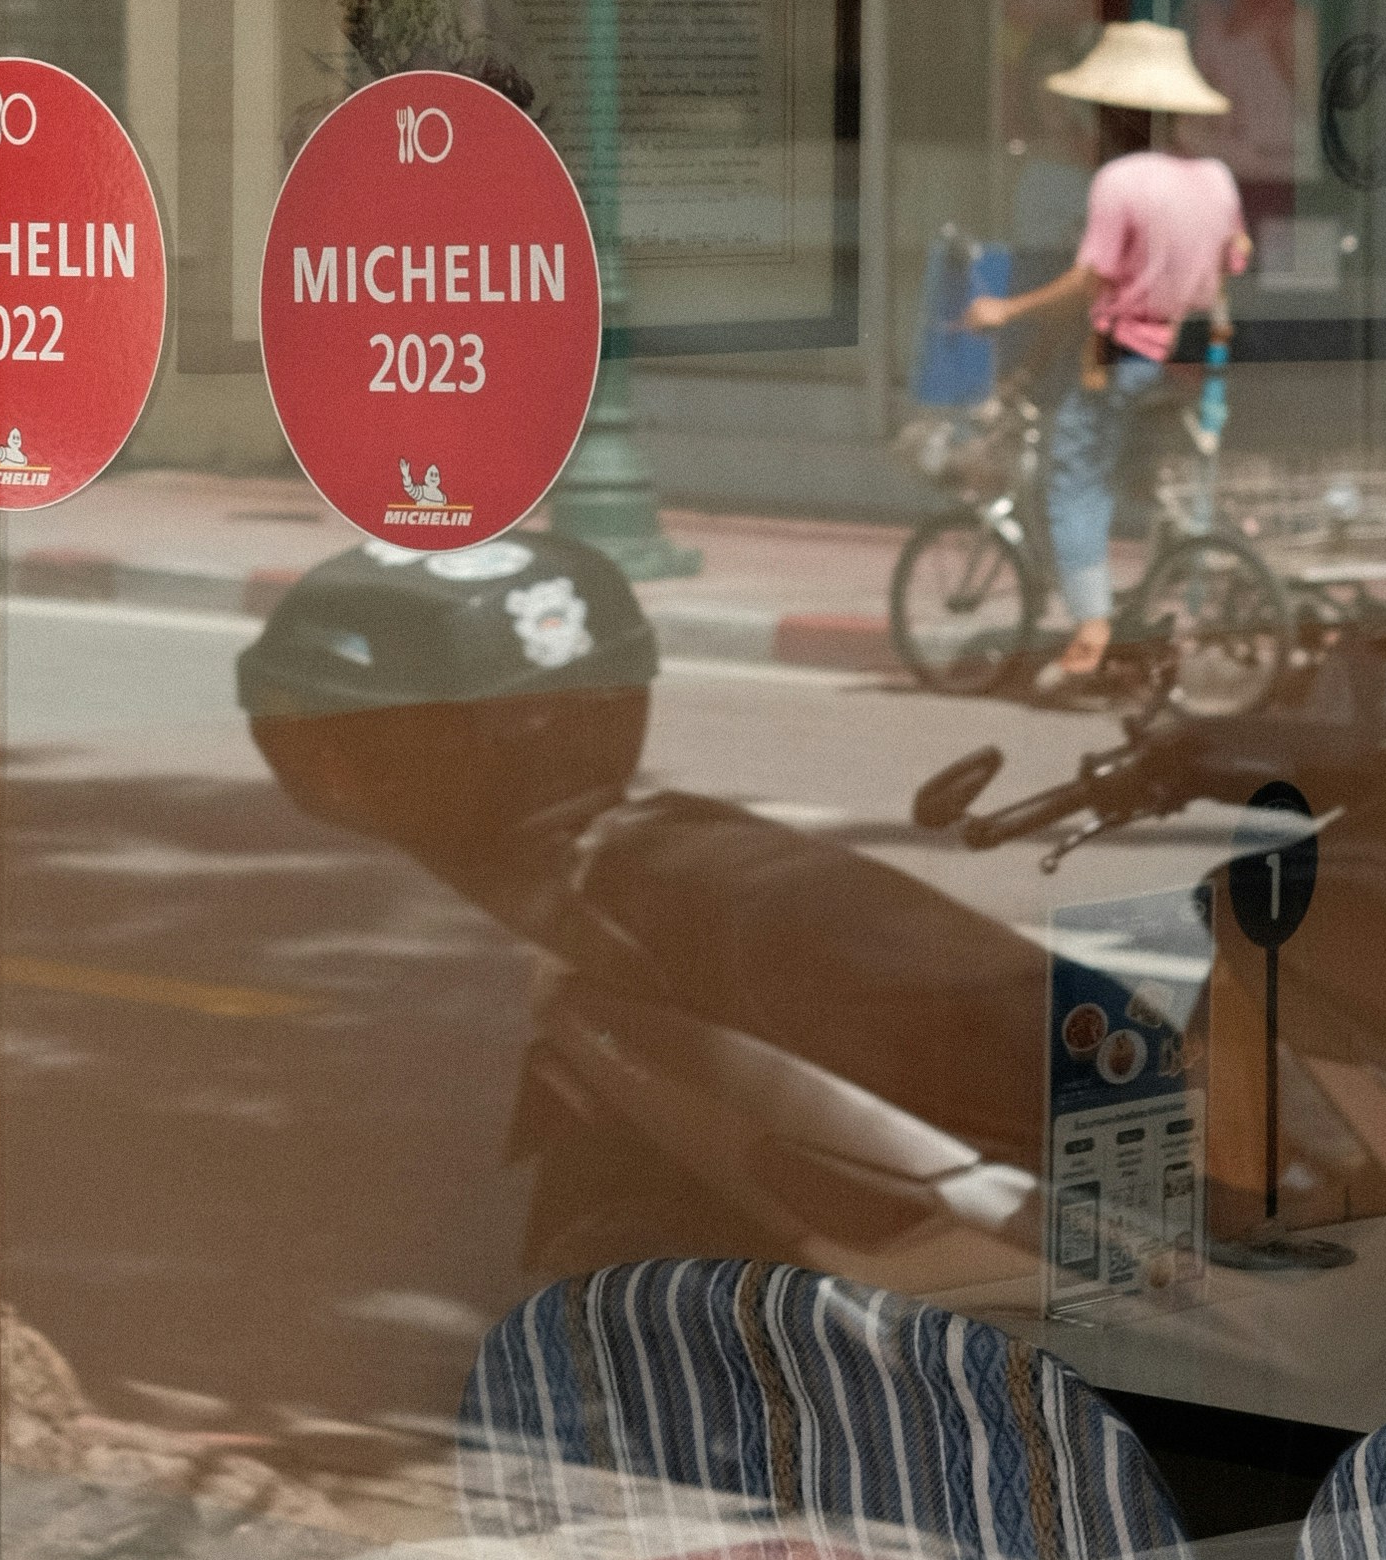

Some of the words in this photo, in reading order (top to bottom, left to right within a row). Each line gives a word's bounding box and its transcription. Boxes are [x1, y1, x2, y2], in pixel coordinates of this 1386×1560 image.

[293, 243, 566, 304] MICHELIN
[369, 333, 487, 395] 2023
[384, 508, 474, 527] MICHELIN
[1265, 851, 1282, 921] 1
